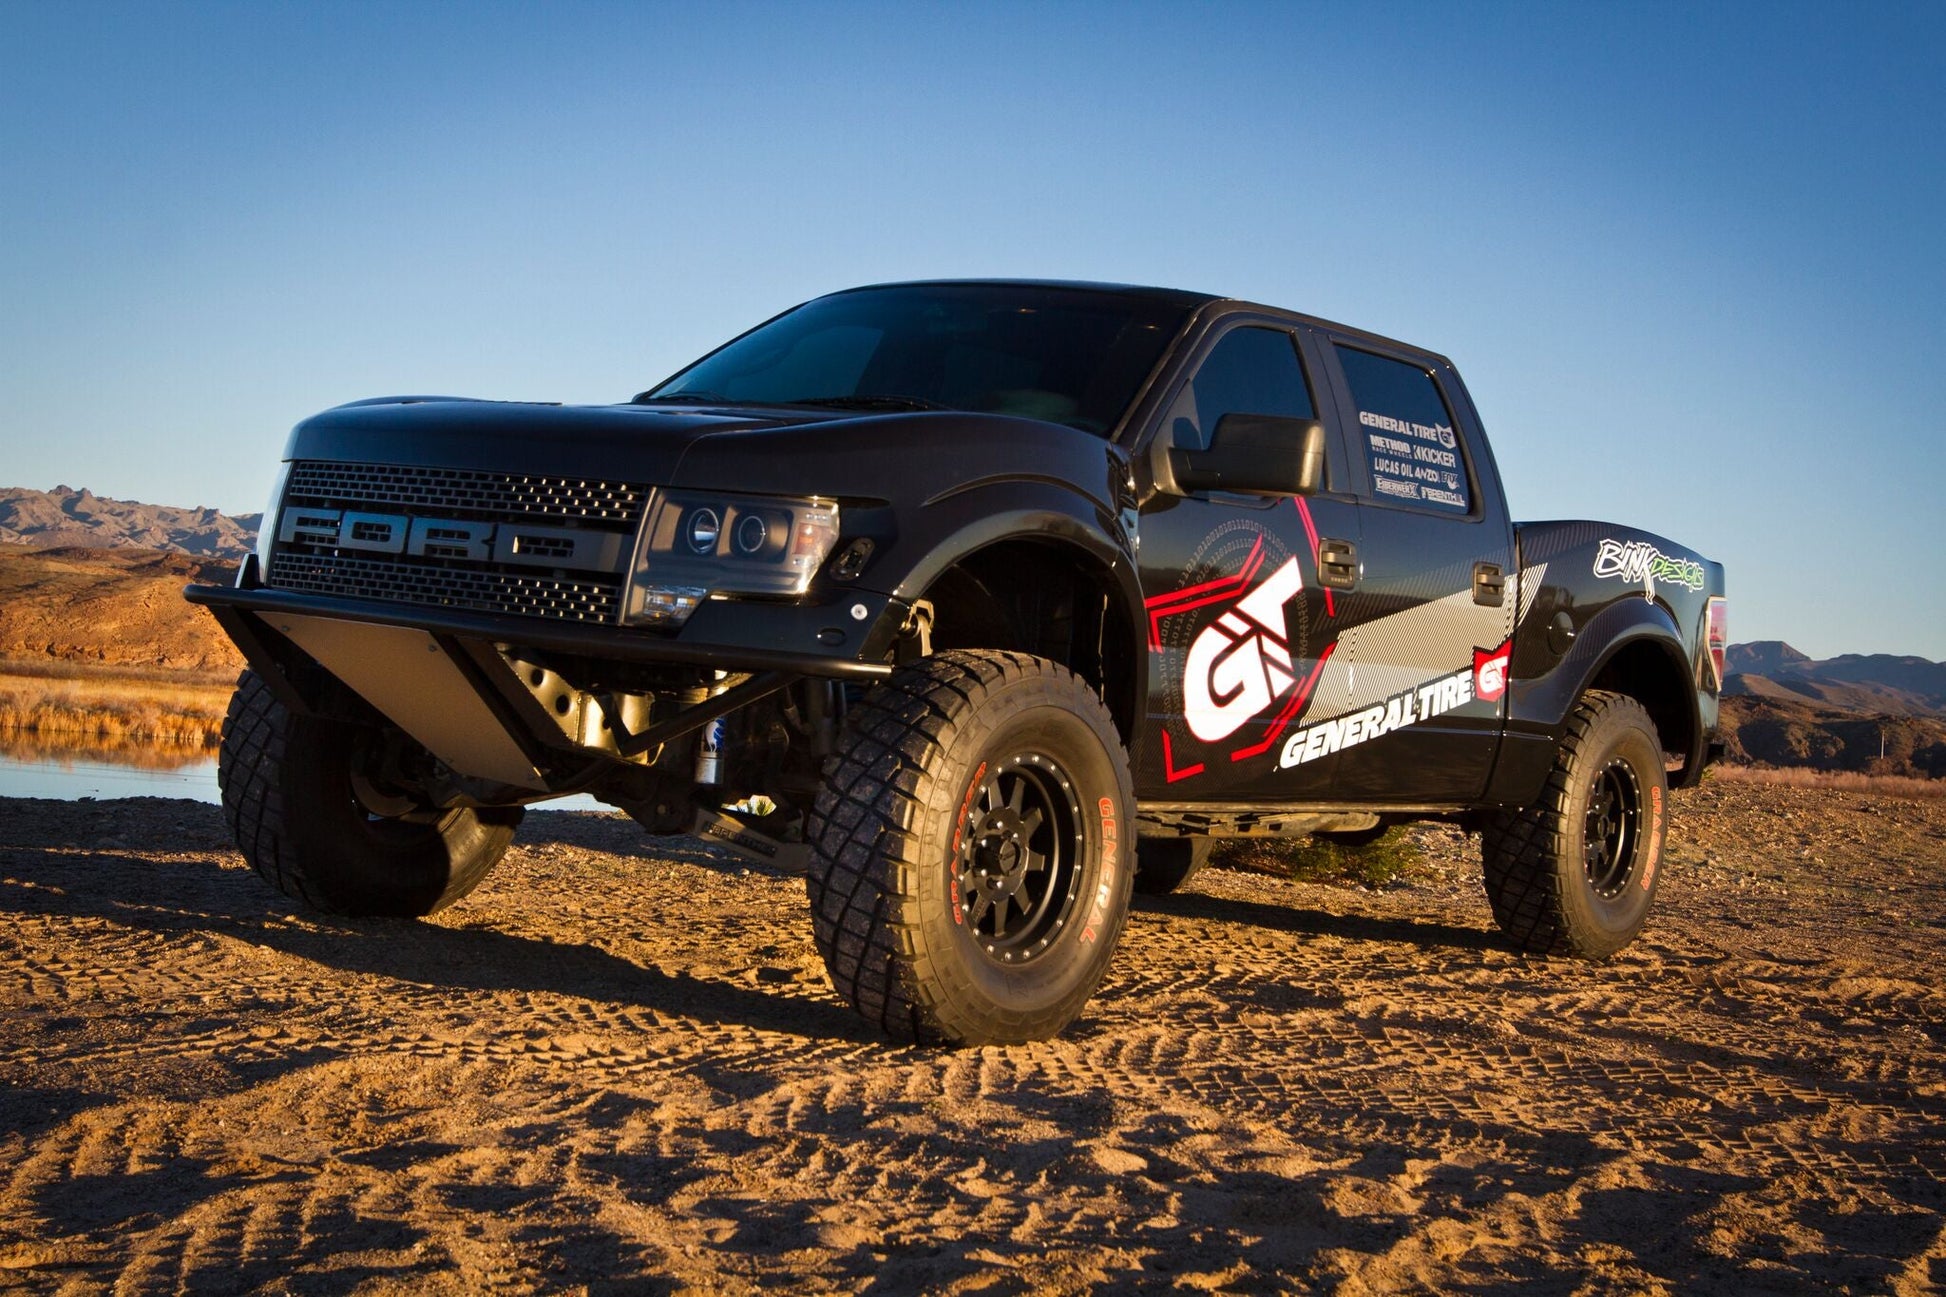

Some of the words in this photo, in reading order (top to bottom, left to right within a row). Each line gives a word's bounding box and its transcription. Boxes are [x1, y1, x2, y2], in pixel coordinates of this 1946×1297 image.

[1360, 411, 1413, 436] GENERAL
[1412, 424, 1438, 441] TIRE
[1369, 434, 1411, 453] METHOD
[1374, 457, 1400, 475] LUCAS
[1401, 463, 1413, 477] OIL
[1420, 446, 1456, 468] KICKER
[278, 506, 621, 574] FORD
[1595, 540, 1657, 602] BINK
[1183, 555, 1303, 743] GT
[1478, 656, 1508, 694] GT
[1279, 693, 1417, 769] GENERAL
[1418, 669, 1473, 721] TIRE
[1079, 797, 1117, 944] GENERAL
